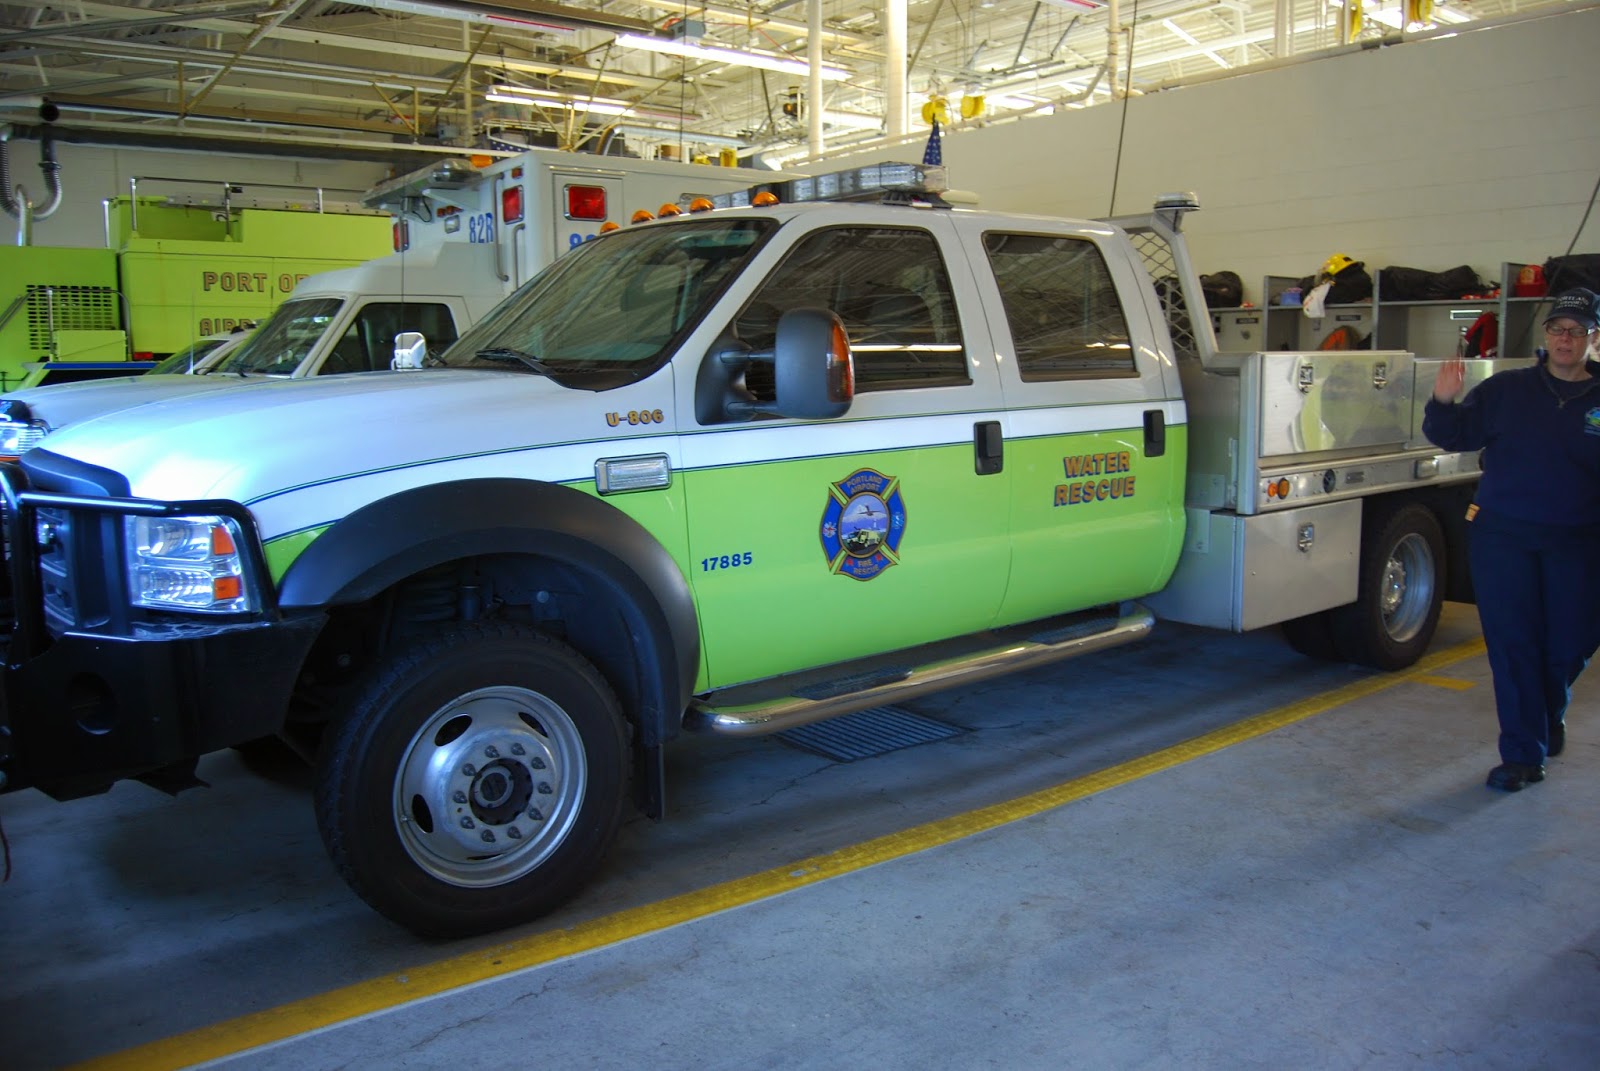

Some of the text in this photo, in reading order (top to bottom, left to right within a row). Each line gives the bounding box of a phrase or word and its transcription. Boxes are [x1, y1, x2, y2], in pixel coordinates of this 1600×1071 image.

[468, 212, 494, 244] 82R
[203, 271, 311, 293] PORT O
[605, 409, 665, 427] U-806
[1063, 451, 1131, 479] WATER
[846, 475, 883, 488] PORTLAND
[850, 483, 881, 494] AIRPORT
[1053, 476, 1136, 507] RESCUE
[701, 551, 753, 572] 17885
[853, 564, 880, 575] RESCUE
[857, 559, 873, 568] FIRE
